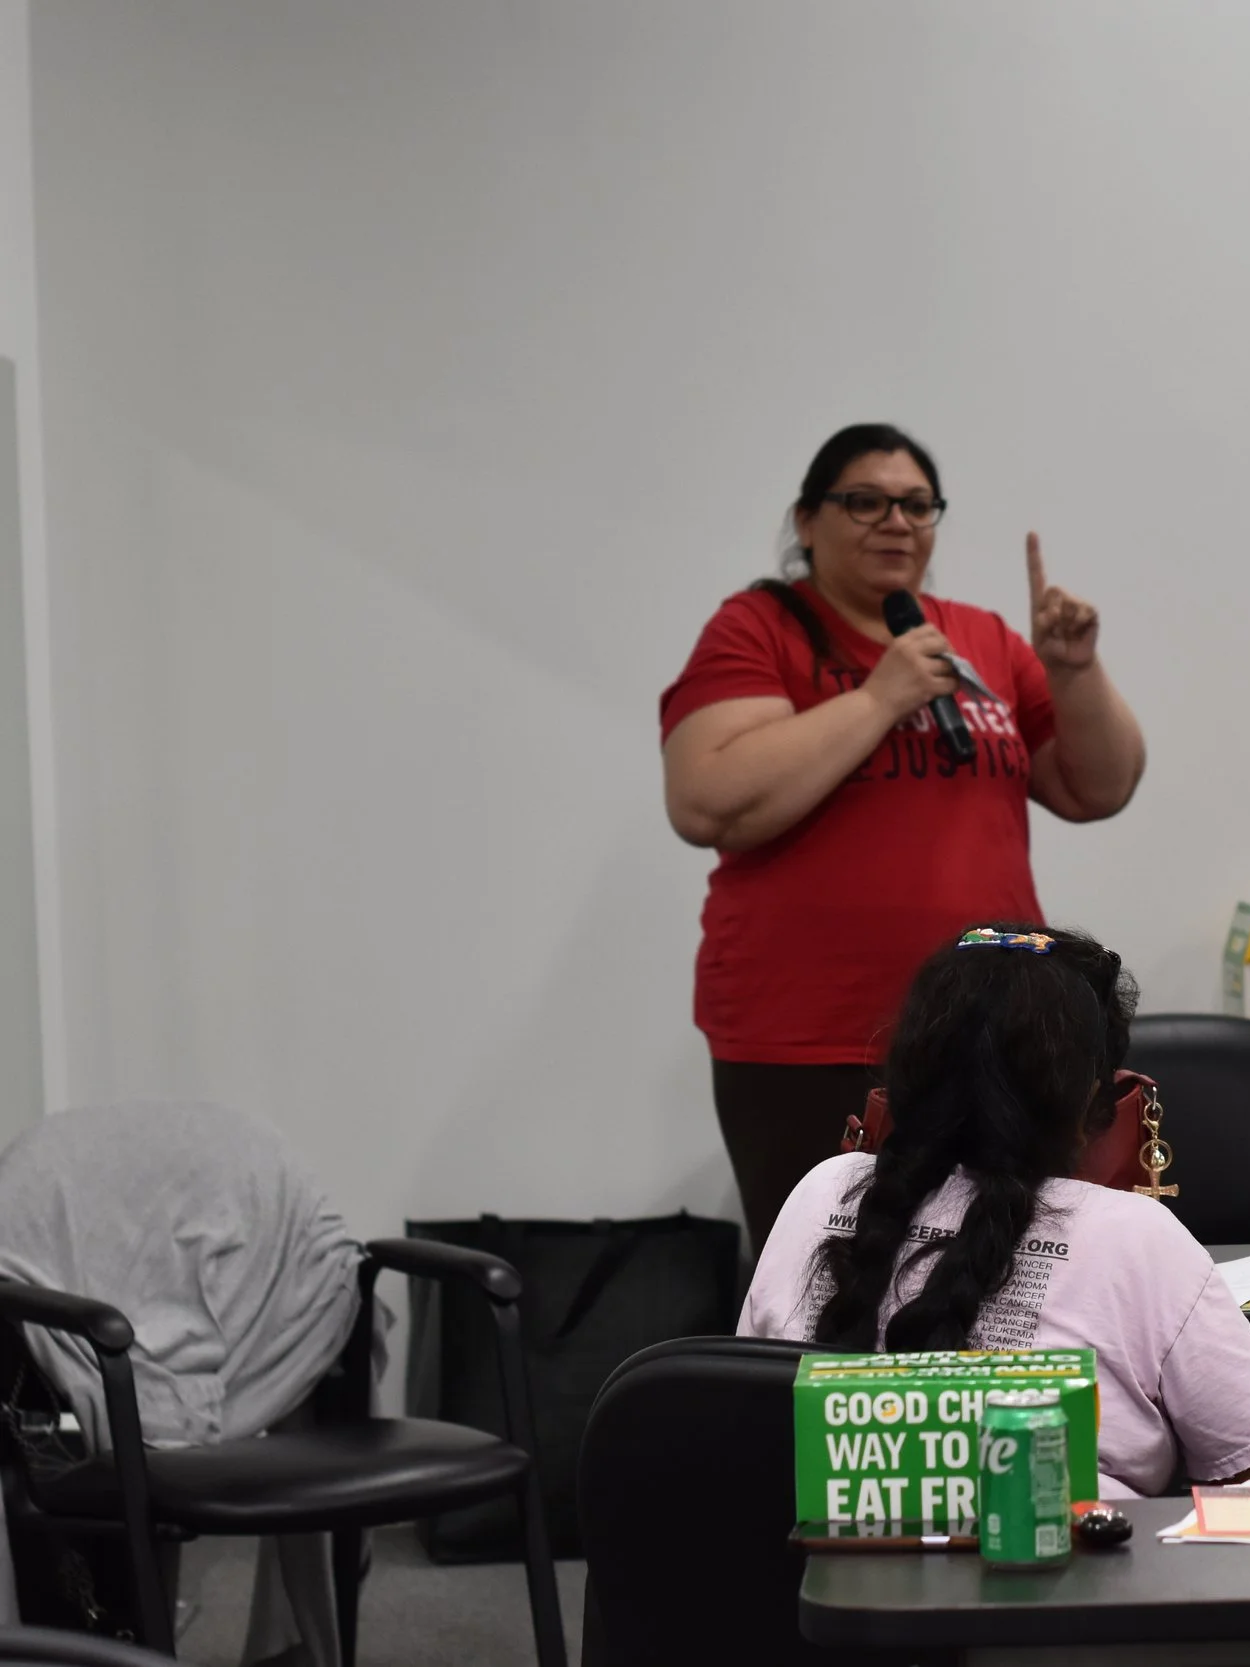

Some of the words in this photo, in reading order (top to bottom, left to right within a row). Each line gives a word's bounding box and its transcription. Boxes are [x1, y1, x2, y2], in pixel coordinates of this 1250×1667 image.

[1011, 1269, 1050, 1281] ANCER
[1002, 1288, 1046, 1300] CANCER
[1000, 1298, 1043, 1310] CANCER
[995, 1307, 1039, 1320] CANCER
[994, 1316, 1038, 1330] CANCER
[981, 1324, 1035, 1340] LEUKEMIA
[988, 1334, 1033, 1348] CANCER
[824, 1391, 928, 1425] GOOD
[826, 1432, 907, 1471] WAY
[919, 1431, 969, 1469] TO
[827, 1477, 909, 1521] EAT
